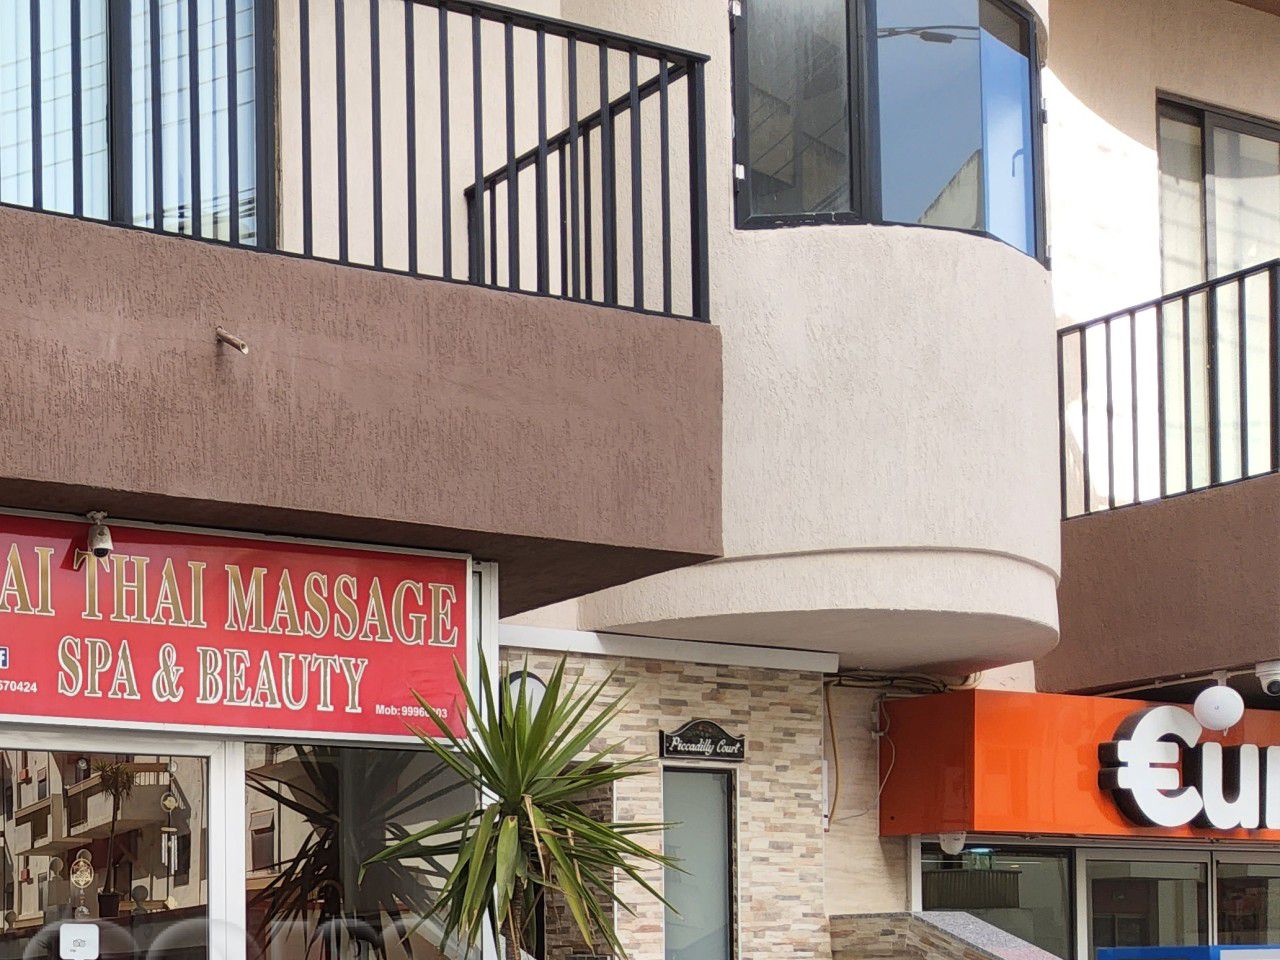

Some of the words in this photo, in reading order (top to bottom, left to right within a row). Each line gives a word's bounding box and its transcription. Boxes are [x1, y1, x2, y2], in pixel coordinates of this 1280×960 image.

[74, 548, 207, 628] THAI
[225, 564, 458, 648] MASSAGE
[58, 635, 141, 699] SPA
[152, 643, 184, 702] &
[196, 647, 368, 713] BEAUTY
[669, 736, 715, 755] Piccadilly
[717, 739, 740, 753] Court
